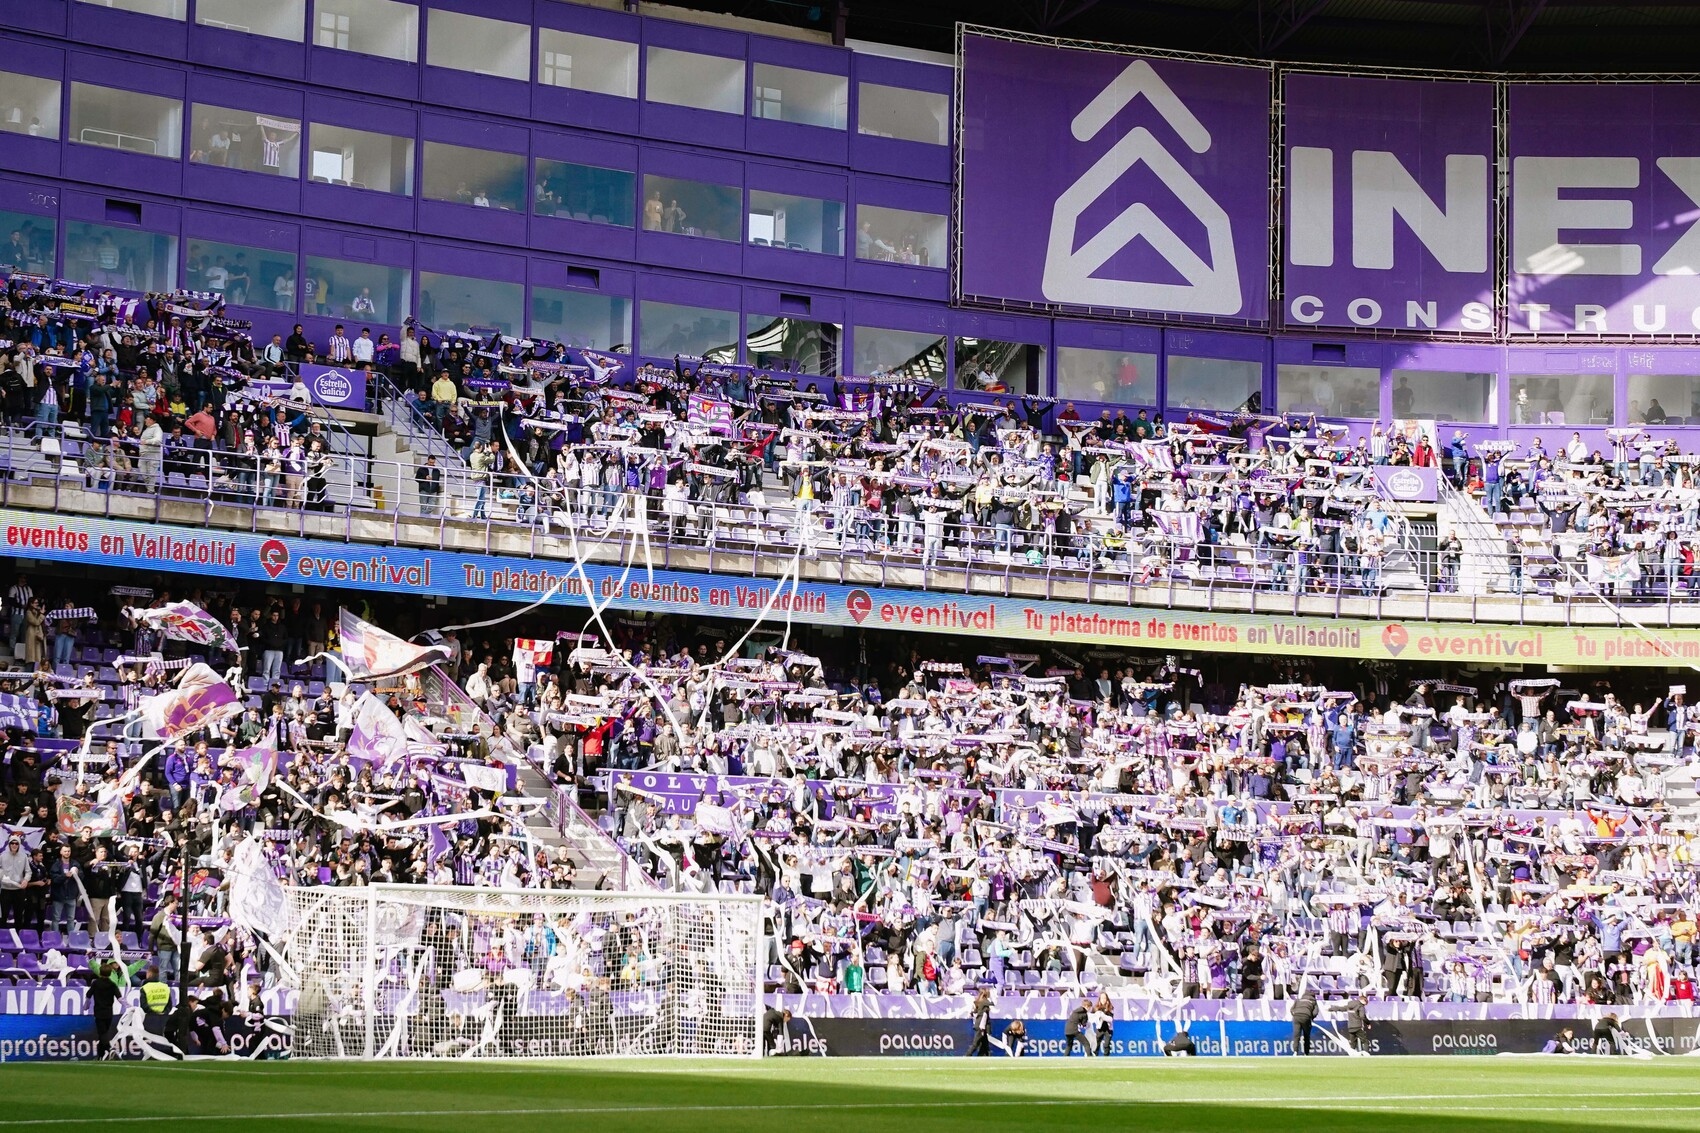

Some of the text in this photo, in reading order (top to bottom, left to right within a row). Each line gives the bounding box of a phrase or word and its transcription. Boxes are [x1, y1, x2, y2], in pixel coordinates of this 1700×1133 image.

[1290, 295, 1700, 331] CONSTRU
[320, 378, 348, 389] Estrella
[320, 386, 346, 397] Galicia
[7, 525, 236, 566] eventos en Valladolid
[298, 556, 430, 586] eventival
[463, 564, 485, 588] Tu
[602, 575, 623, 599] de
[630, 581, 700, 605] eventos
[709, 587, 731, 607] en
[880, 602, 995, 630] eventival
[1023, 607, 1361, 649] Tu plataforma de eventos en Valladolid
[1417, 632, 1543, 658] eventival
[1574, 634, 1597, 657] Tu
[880, 1034, 954, 1053] palausa
[1128, 1039, 1148, 1054] en
[1234, 1039, 1269, 1056] para
[1432, 1033, 1497, 1051] palausa
[1657, 1036, 1675, 1050] en
